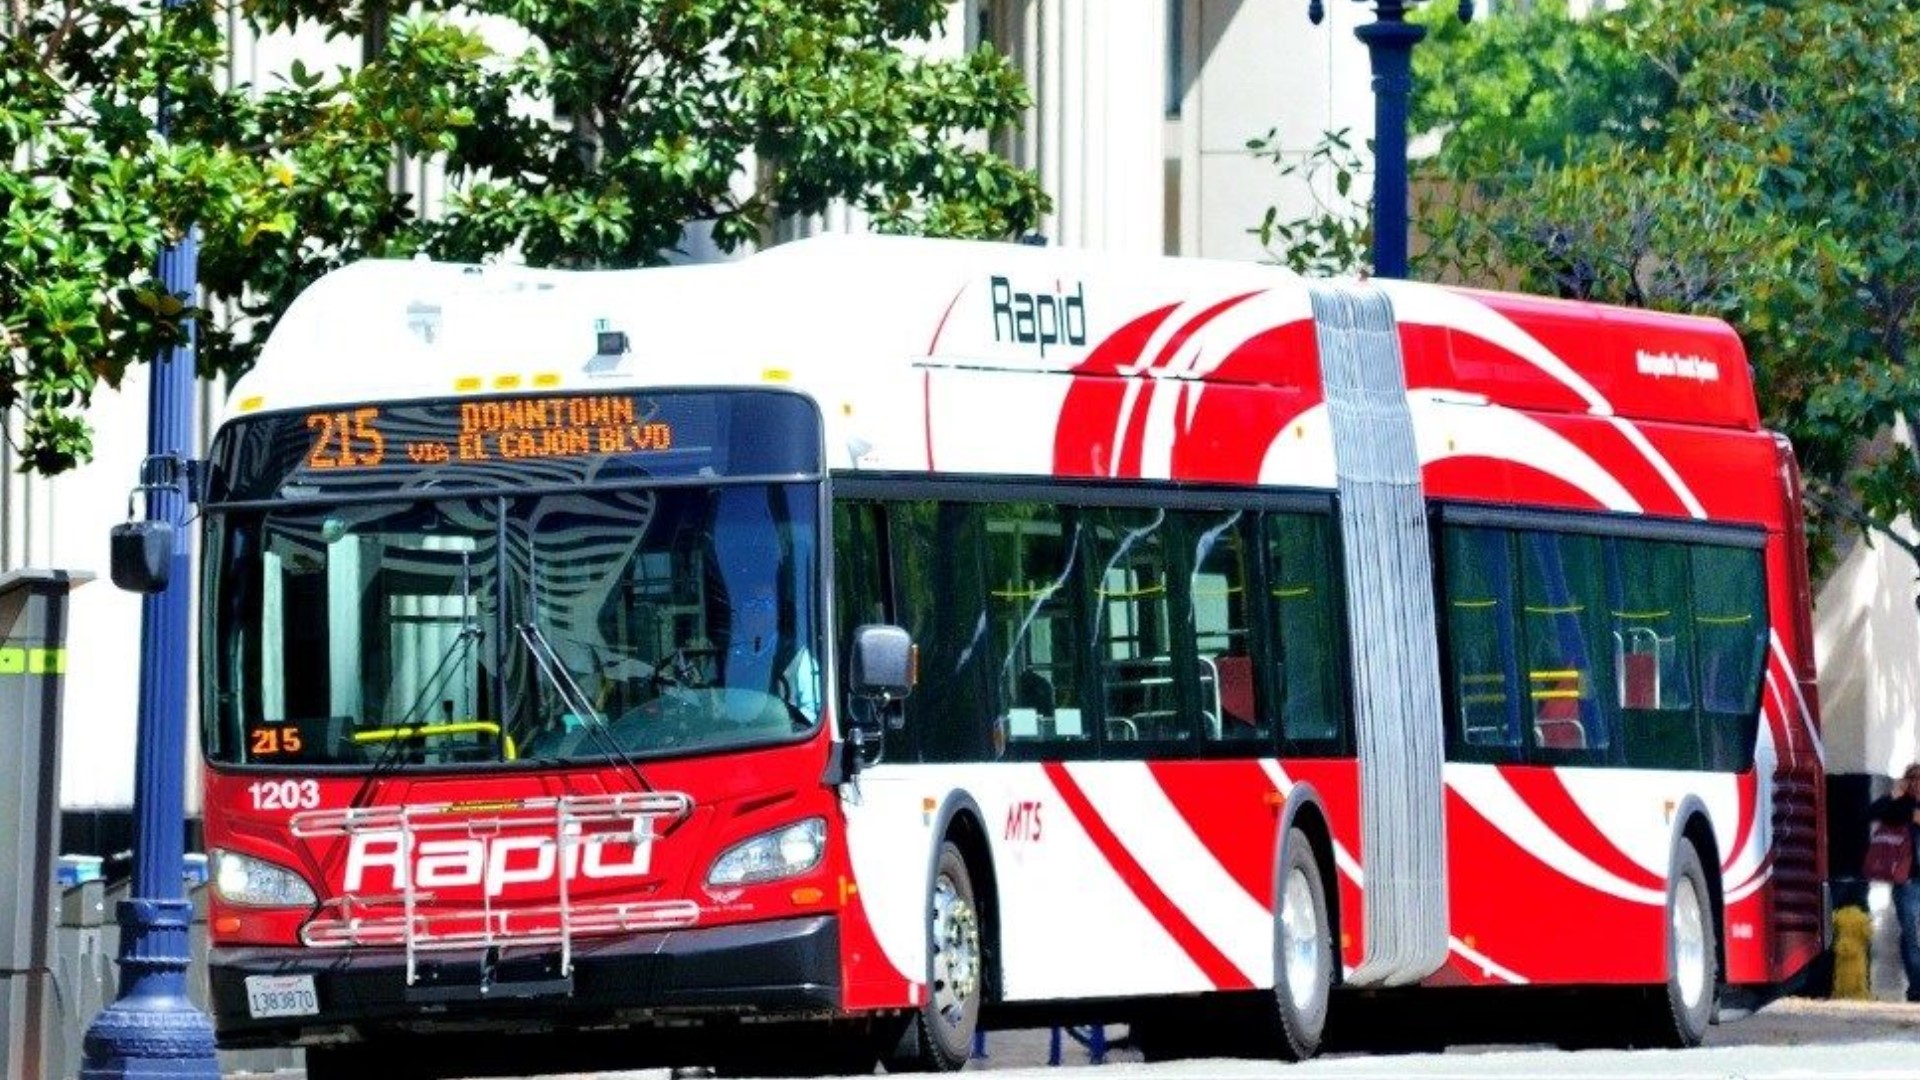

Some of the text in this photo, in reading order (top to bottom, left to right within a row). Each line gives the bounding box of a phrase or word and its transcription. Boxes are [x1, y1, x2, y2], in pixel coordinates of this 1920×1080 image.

[991, 275, 1086, 359] Rapid
[461, 397, 634, 433] DOWNTOWN
[306, 408, 384, 469] 215
[458, 433, 488, 460] EL
[500, 427, 590, 458] CAJON
[599, 424, 671, 451] BLVD
[252, 727, 302, 754] 215
[248, 780, 320, 810] 1203
[1004, 801, 1042, 841] MTS
[343, 816, 653, 896] Rapid
